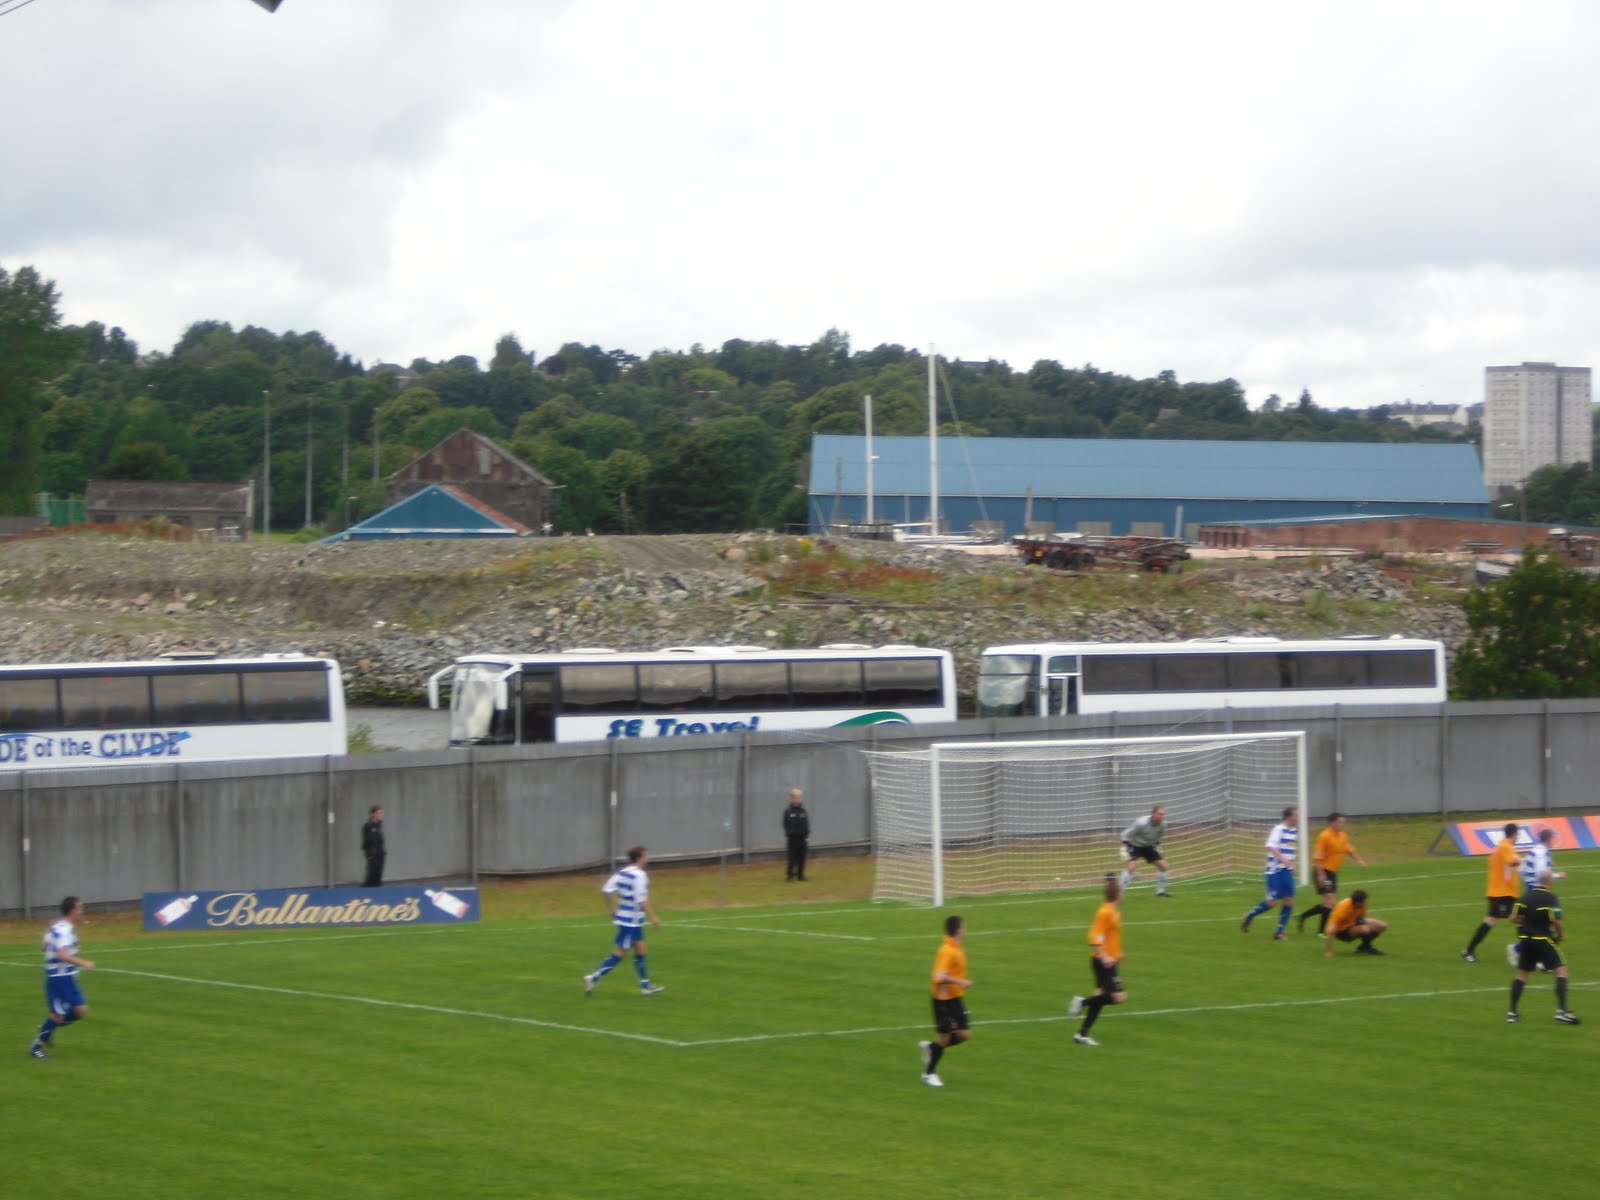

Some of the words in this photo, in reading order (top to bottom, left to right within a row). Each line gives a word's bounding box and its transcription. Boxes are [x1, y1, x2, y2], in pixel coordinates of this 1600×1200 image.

[34, 739, 53, 757] of
[61, 738, 92, 756] the
[101, 731, 181, 758] CLYDE
[206, 892, 421, 927] Ballantine's
